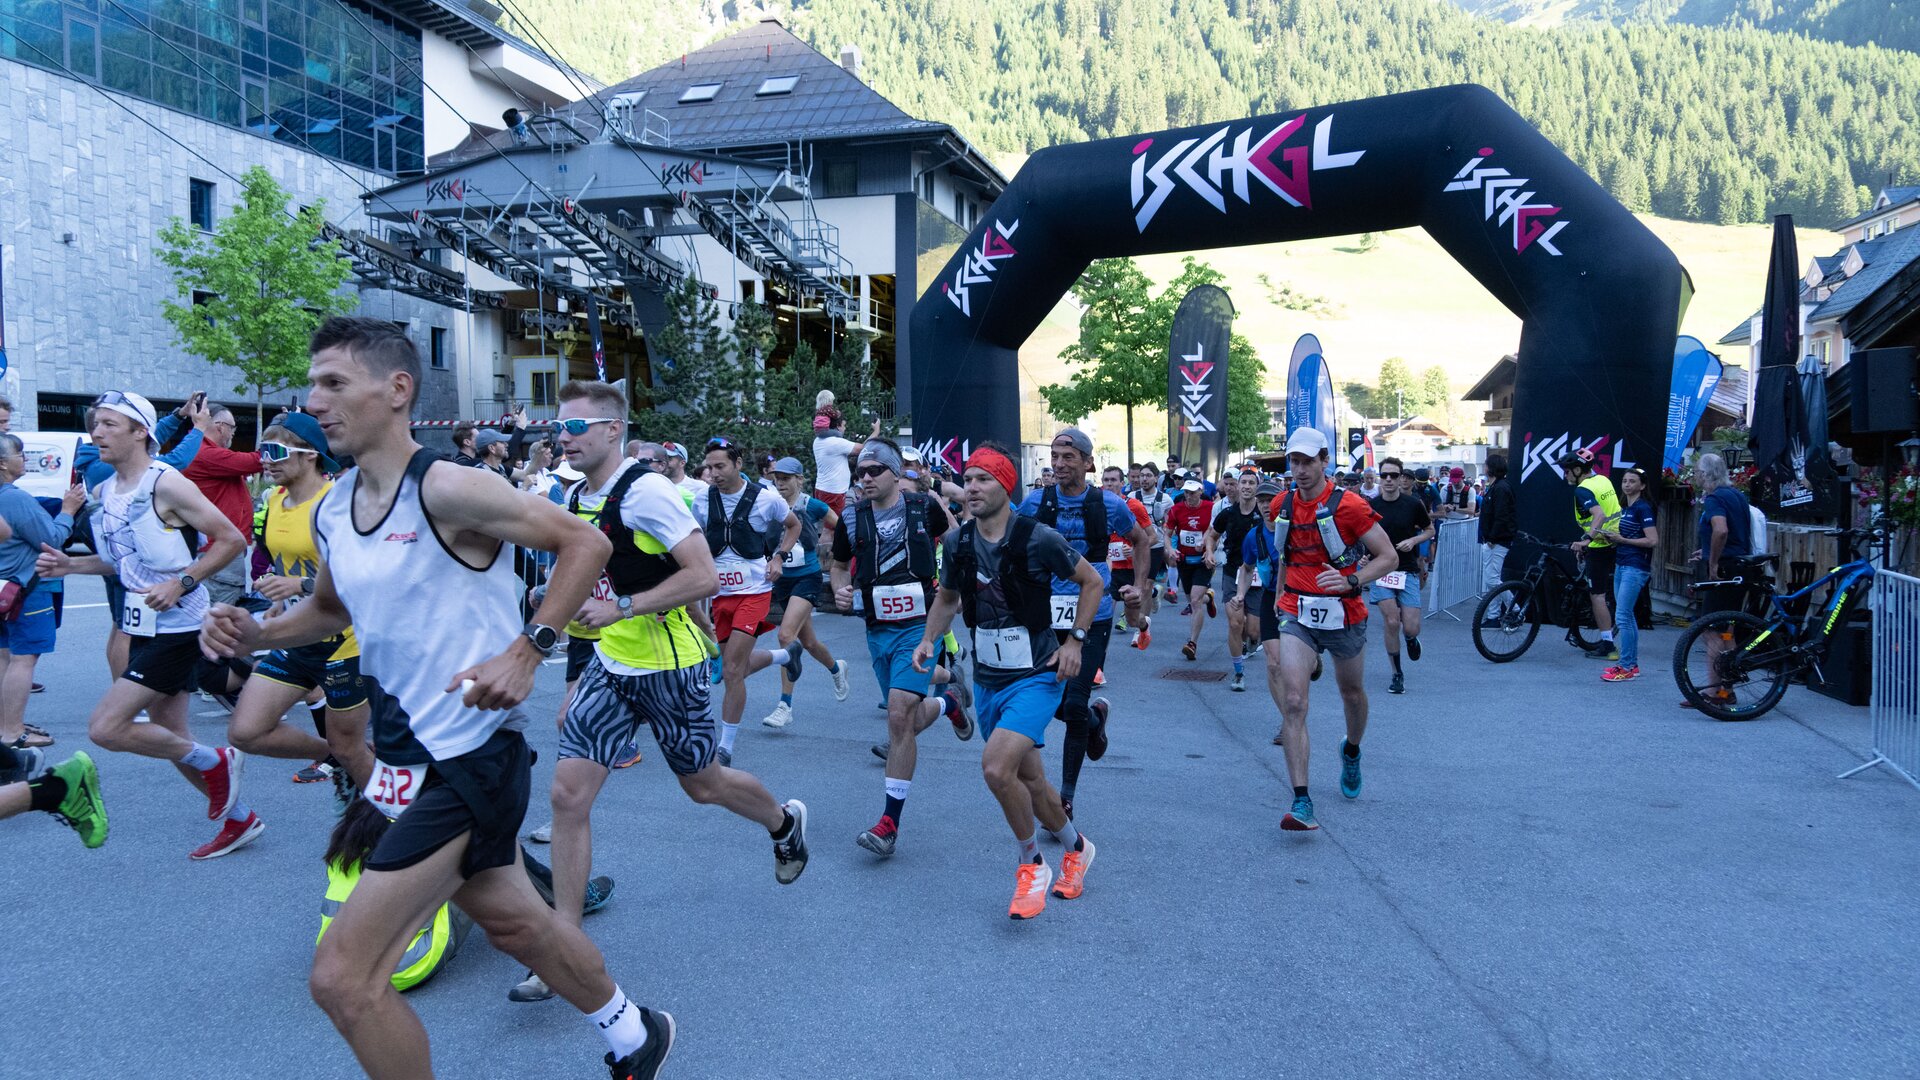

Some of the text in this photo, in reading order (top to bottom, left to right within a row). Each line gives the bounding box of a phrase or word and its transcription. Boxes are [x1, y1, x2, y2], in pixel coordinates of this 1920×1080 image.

[1185, 535, 1196, 545] 83
[718, 571, 744, 586] 560
[1381, 575, 1400, 586] 463
[881, 595, 914, 615] 553
[1055, 606, 1075, 623] 74
[1310, 607, 1329, 624] 97
[1003, 634, 1020, 642] TONI
[994, 642, 1002, 662] 1
[374, 766, 414, 806] 532
